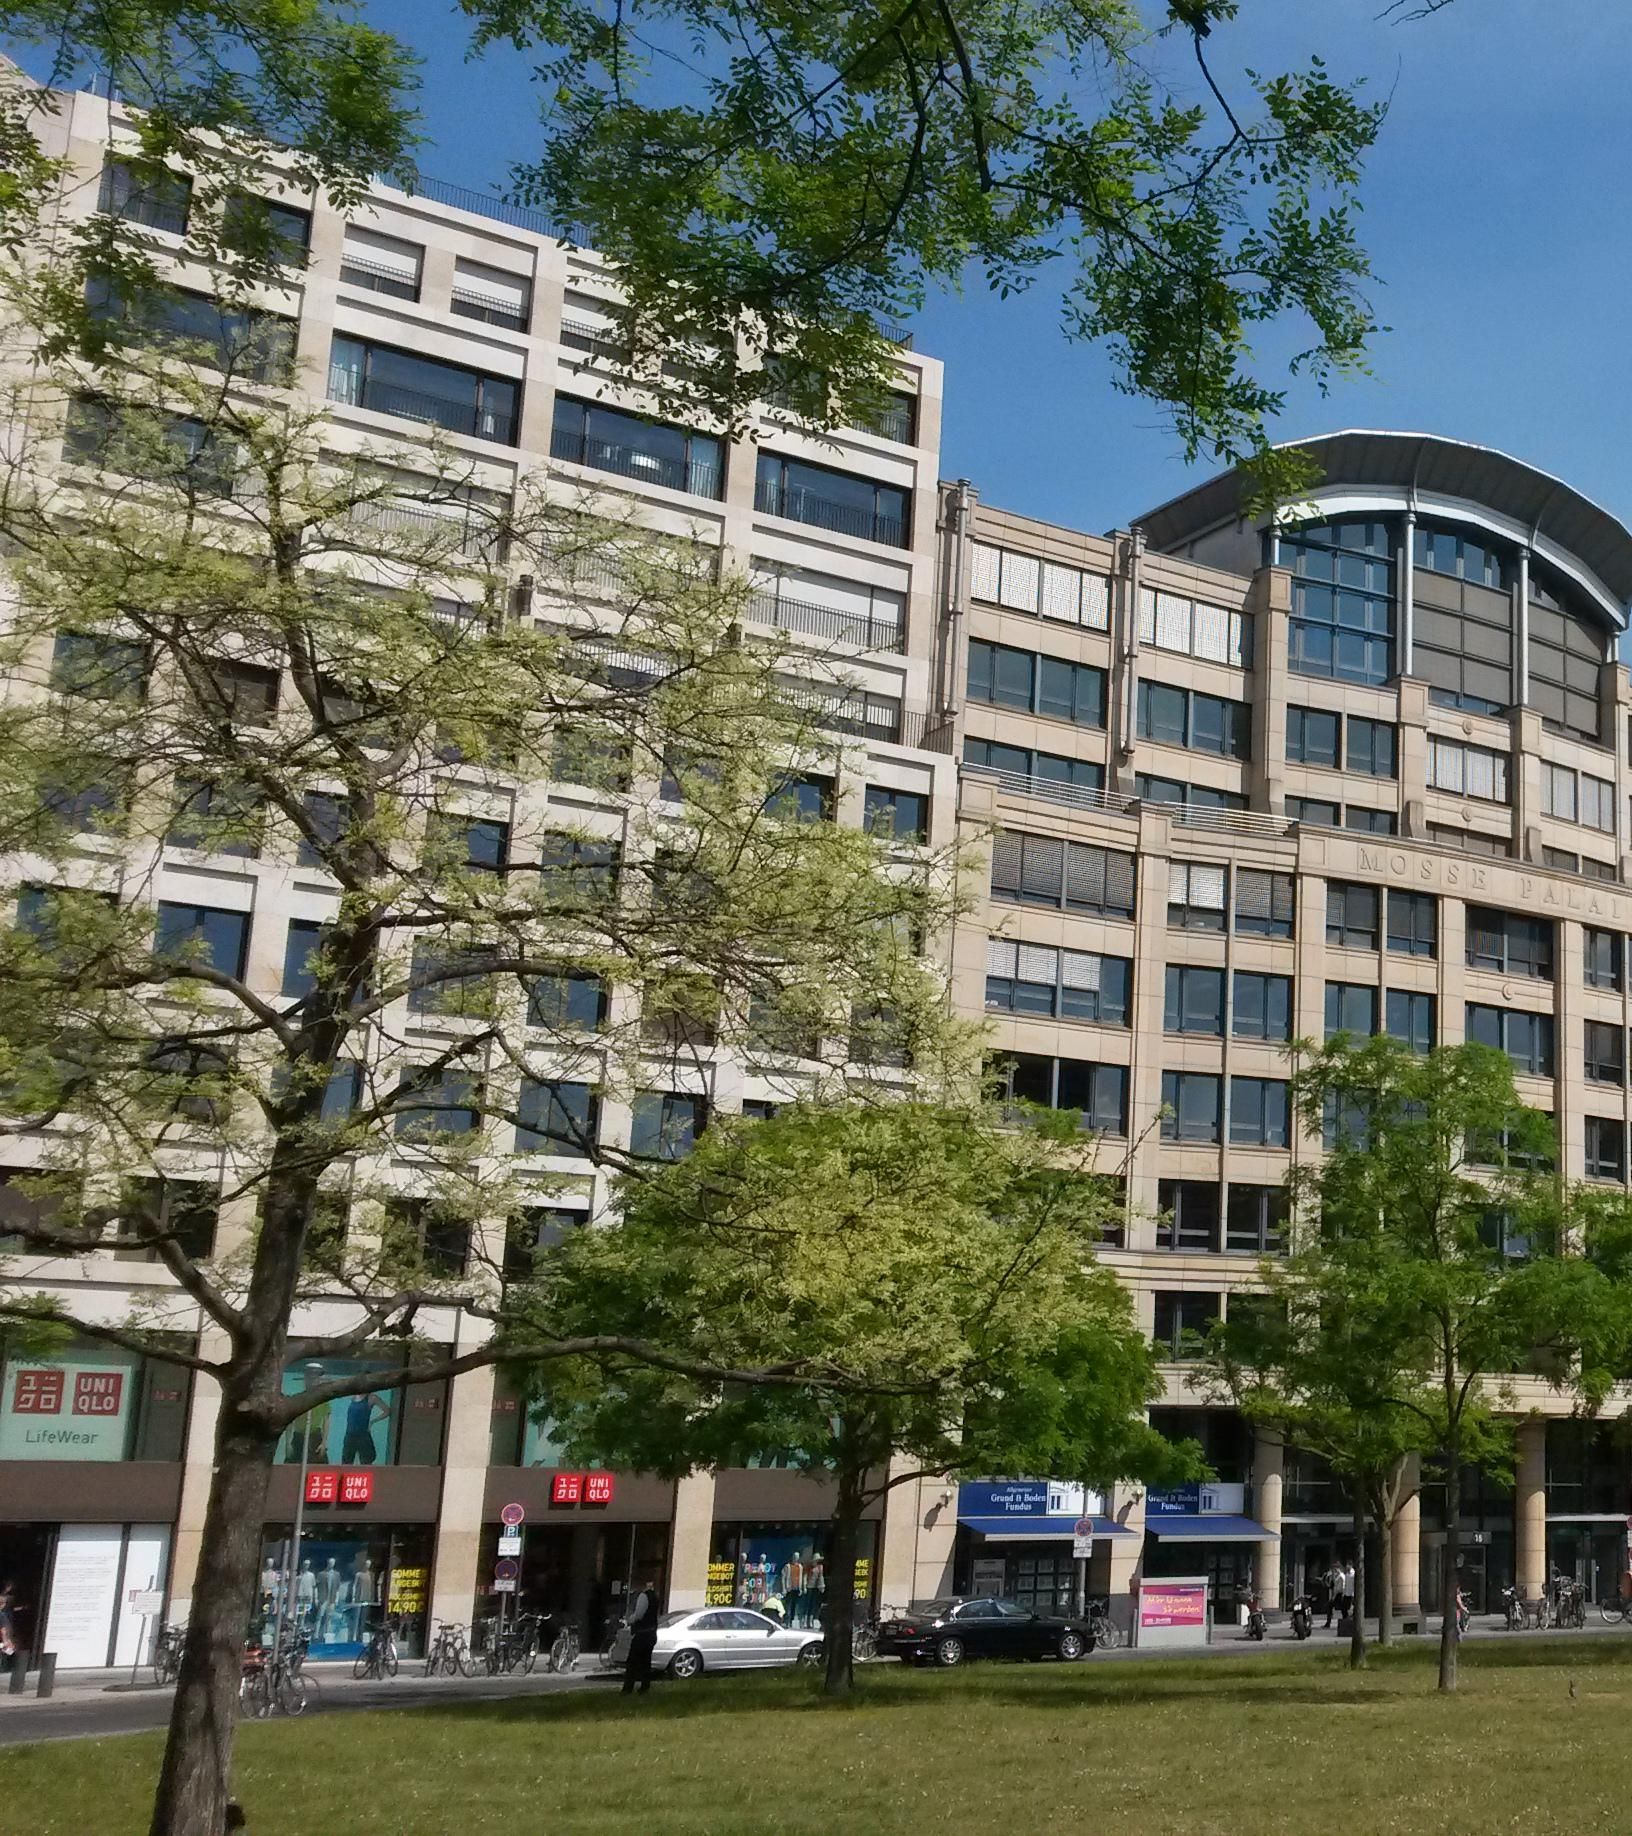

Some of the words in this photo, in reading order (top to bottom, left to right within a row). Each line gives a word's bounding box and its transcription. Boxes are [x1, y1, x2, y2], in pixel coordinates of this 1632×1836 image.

[1359, 847, 1487, 891] MOSSE
[80, 1377, 114, 1394] UNI
[78, 1396, 115, 1413] QLO
[25, 1429, 99, 1444] LifeWear
[346, 1477, 368, 1487] UNI
[589, 1478, 609, 1488] UNI
[345, 1488, 368, 1499] QLO
[589, 1489, 610, 1499] QLO
[990, 1493, 1014, 1502] Grund
[1024, 1493, 1047, 1502] Boden
[1005, 1502, 1033, 1511] Fundus
